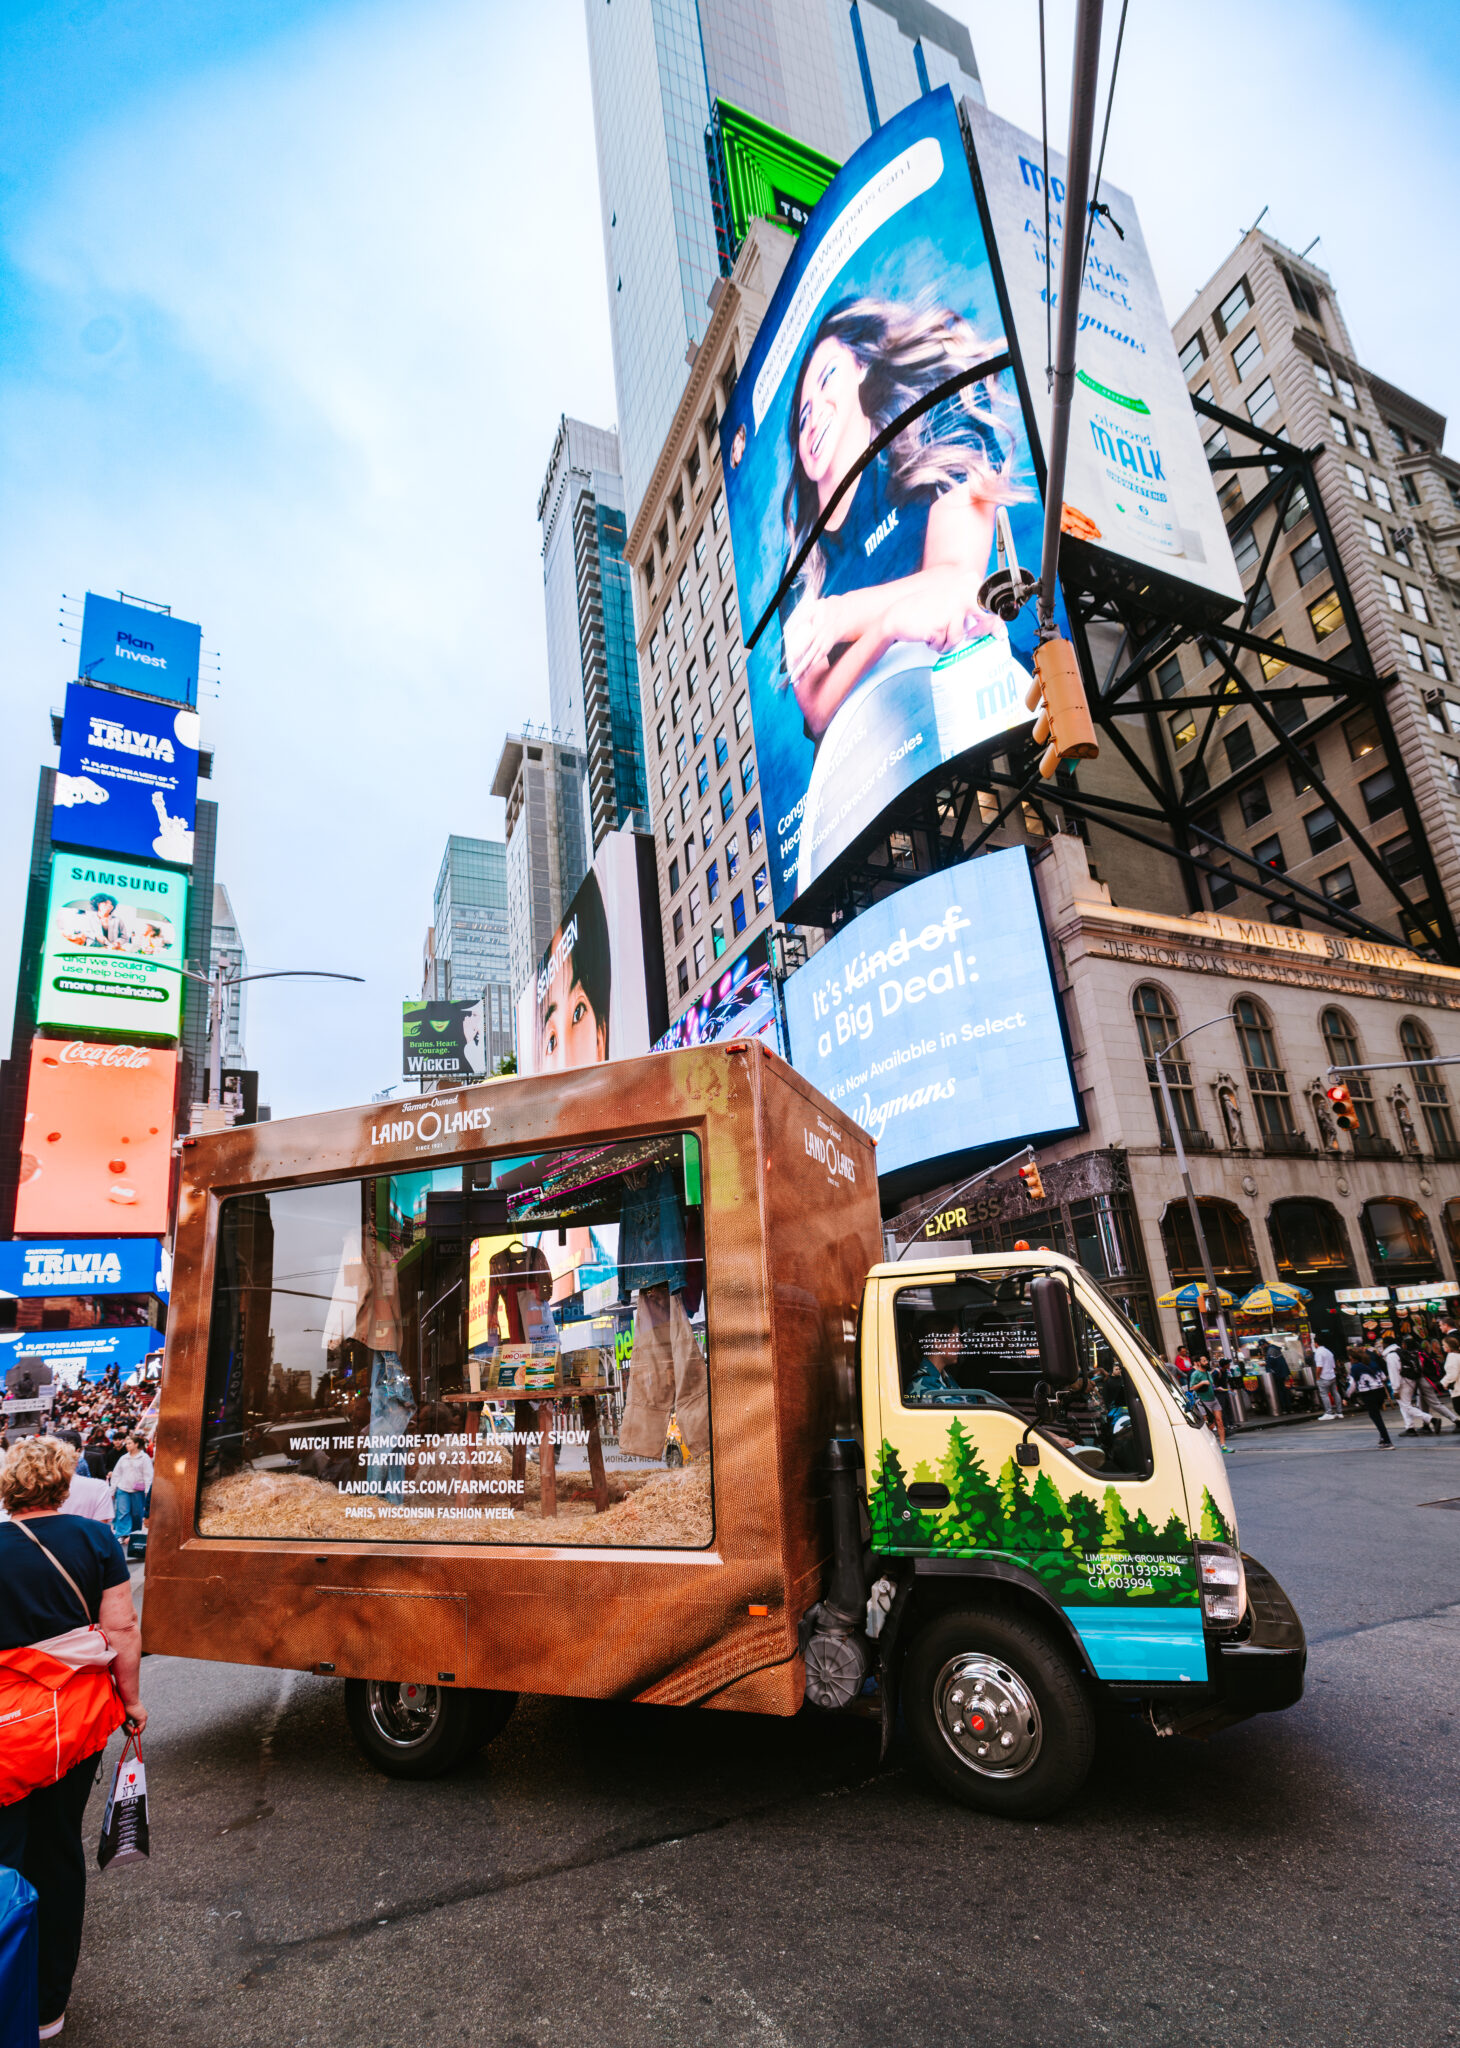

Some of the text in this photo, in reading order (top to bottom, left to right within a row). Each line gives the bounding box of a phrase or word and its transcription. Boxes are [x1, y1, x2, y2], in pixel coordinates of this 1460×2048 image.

[1018, 155, 1107, 230] MAK
[818, 194, 876, 262] Wegmans
[1089, 419, 1166, 482] MALK
[864, 506, 899, 557] MALK
[116, 631, 154, 652] Plan
[115, 645, 167, 669] Invest
[88, 734, 174, 763] MOMENTS
[89, 721, 175, 754] TRIVIA
[841, 776, 877, 819] Director
[877, 757, 889, 780] of
[888, 732, 923, 766] Sales
[71, 867, 169, 894] SAMSUNG
[537, 913, 578, 1004] SEVENTEEN
[1237, 922, 1310, 951] MILLER
[1323, 936, 1404, 968] BUILDING
[62, 966, 83, 974] use
[114, 971, 146, 983] being
[812, 905, 968, 1020] It's Kind of
[1105, 940, 1133, 959] THE
[1139, 945, 1180, 965] SHOW
[1186, 953, 1229, 973] FOLKS
[1233, 960, 1266, 977] SHOE
[1271, 966, 1303, 984] SHOP
[1306, 972, 1368, 996] DEDICATED
[59, 980, 93, 992] more
[817, 951, 980, 1058] a Big Deal:
[836, 1084, 845, 1099] is
[845, 1071, 868, 1094] Now
[870, 1037, 937, 1079] Available
[940, 1031, 957, 1049] in
[961, 1011, 1027, 1043] Select
[401, 1094, 459, 1113] Farmer-Owned
[852, 1077, 956, 1140] Wegmans
[371, 1109, 492, 1145] LAND O LAKES
[804, 1127, 826, 1163] LAND
[837, 1149, 856, 1183] LAKES
[925, 1197, 1001, 1238] EXPRESS
[25, 1253, 121, 1273] TRIVIA
[22, 1270, 121, 1286] MOMENTS
[289, 1437, 330, 1450] WATCH
[332, 1436, 354, 1449] THE
[357, 1432, 483, 1449] FARMCORE-TO-TABLE
[487, 1431, 544, 1447] RUNWAY
[548, 1430, 590, 1445] SHOW
[358, 1450, 502, 1466] STARTING ON 9.23.2024
[338, 1478, 525, 1495] LANDOLAKES.COM/FARMCORE
[345, 1507, 515, 1519] PARIS, WISCONSIN FASHION WEEK
[1085, 1553, 1105, 1562] LIME
[1106, 1554, 1133, 1562] MEDIA
[1134, 1555, 1166, 1564] GROUP,
[1087, 1563, 1182, 1577] USDOT1939534
[1088, 1576, 1153, 1588] CA 603994
[122, 1784, 138, 1798] NY
